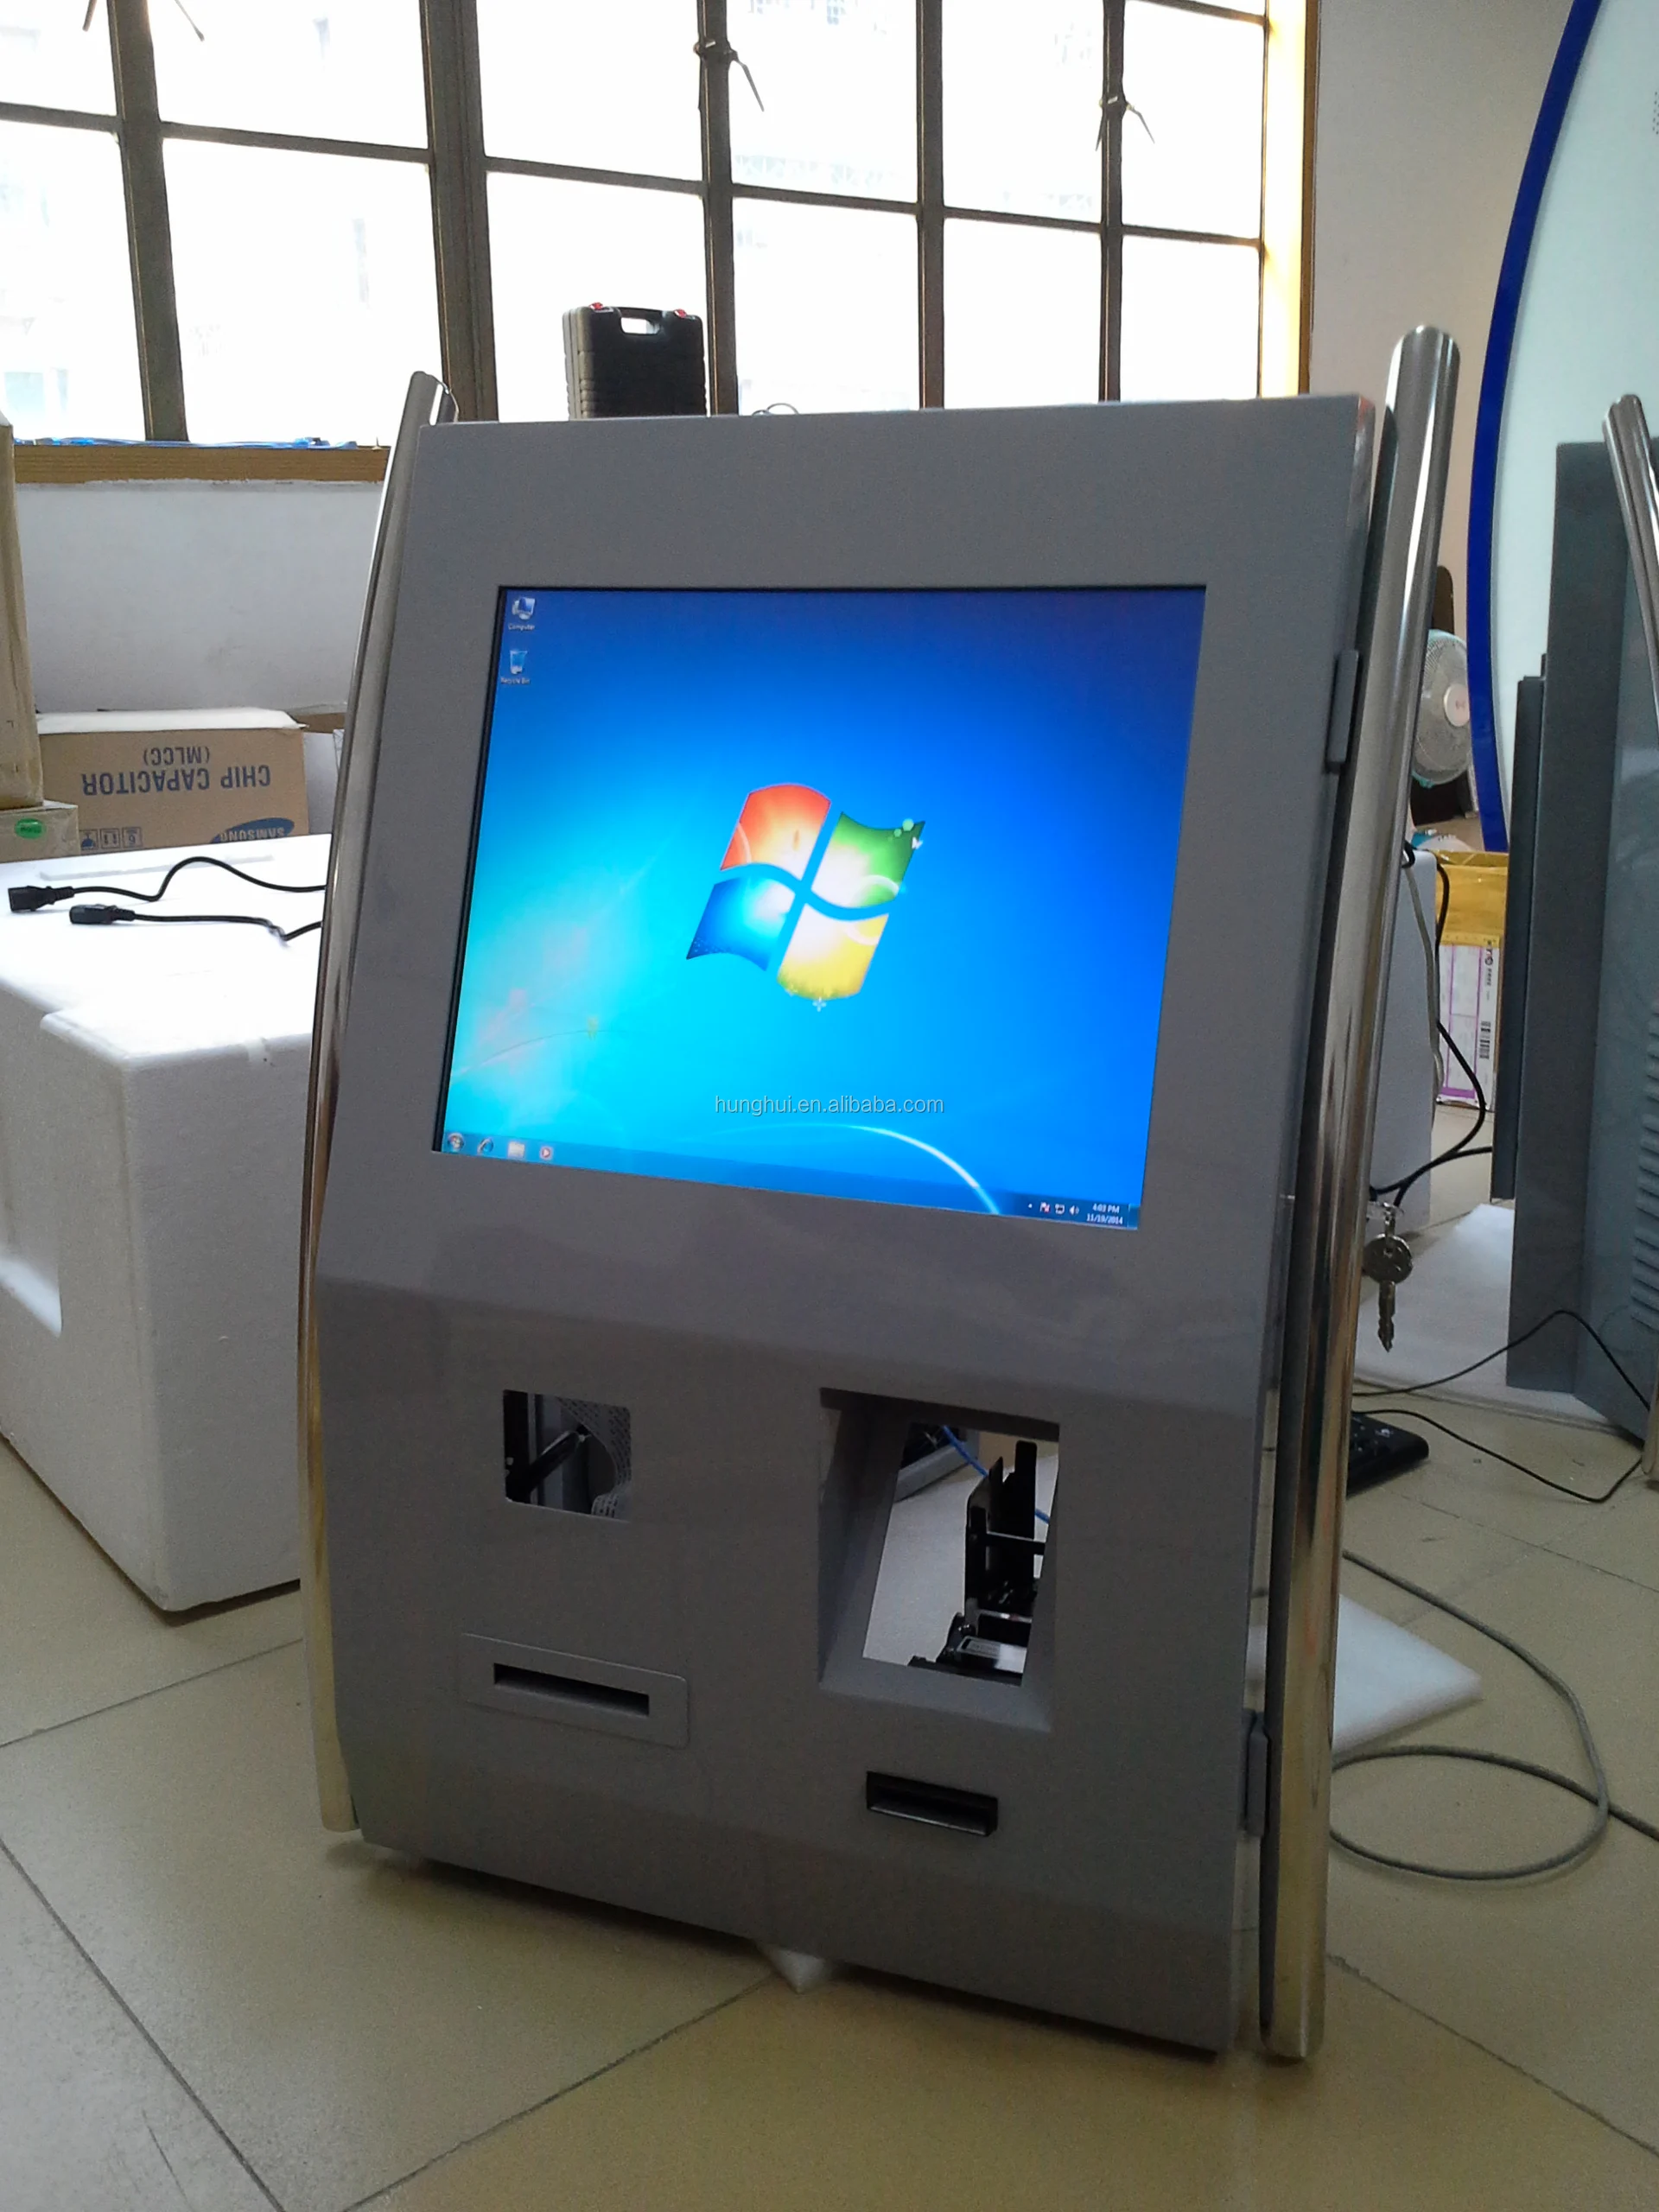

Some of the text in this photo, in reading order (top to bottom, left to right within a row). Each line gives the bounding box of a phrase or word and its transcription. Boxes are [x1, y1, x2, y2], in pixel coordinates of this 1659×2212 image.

[143, 746, 210, 766] (MLCC)
[81, 765, 271, 796] CHIP CAPACITOR
[1107, 1204, 1120, 1214] PM
